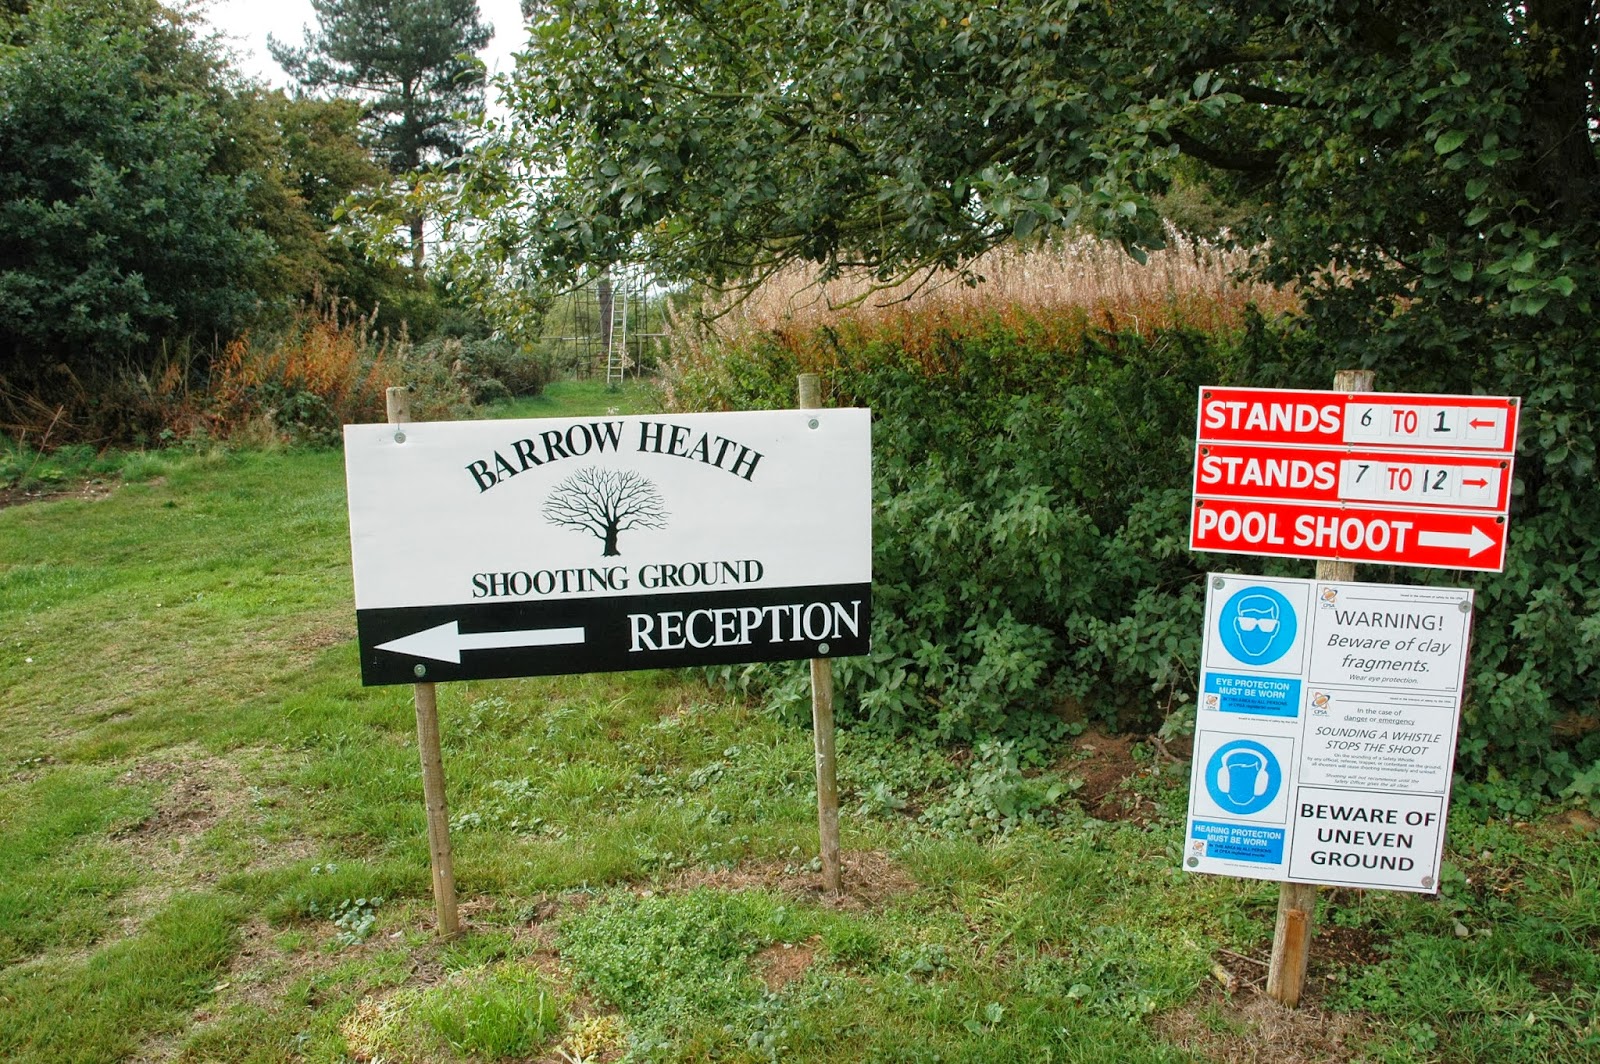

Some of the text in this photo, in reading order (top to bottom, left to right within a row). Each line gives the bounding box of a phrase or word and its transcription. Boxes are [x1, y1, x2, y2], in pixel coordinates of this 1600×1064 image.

[1204, 400, 1451, 434] STANDS 6 TO 1
[465, 421, 765, 494] BARROW HEATH
[1201, 455, 1448, 492] STANDS 7 TO 12
[1197, 509, 1413, 553] POOL SHOOT
[472, 559, 765, 599] SHOOTING GROUND
[627, 600, 862, 653] RECEPTION
[1335, 610, 1444, 631] WARNING!
[1327, 633, 1451, 656] Beware of clay
[1342, 654, 1430, 672] fragments.
[1216, 678, 1290, 691] EYE PROTECTION
[1219, 687, 1286, 699] MUST BE WORN
[1344, 715, 1368, 723] danger
[1378, 717, 1415, 726] emergency
[1315, 726, 1442, 744] SOUNDING A WHISTLE
[1325, 740, 1429, 756] STOPS THE SHOOT
[1301, 803, 1436, 826] BEWARE OF
[1194, 824, 1281, 839] HEARING PROTECTION
[1207, 834, 1268, 846] MUST BE WORN
[1317, 828, 1414, 848] UNEVEN
[1310, 851, 1414, 872] GROUND
